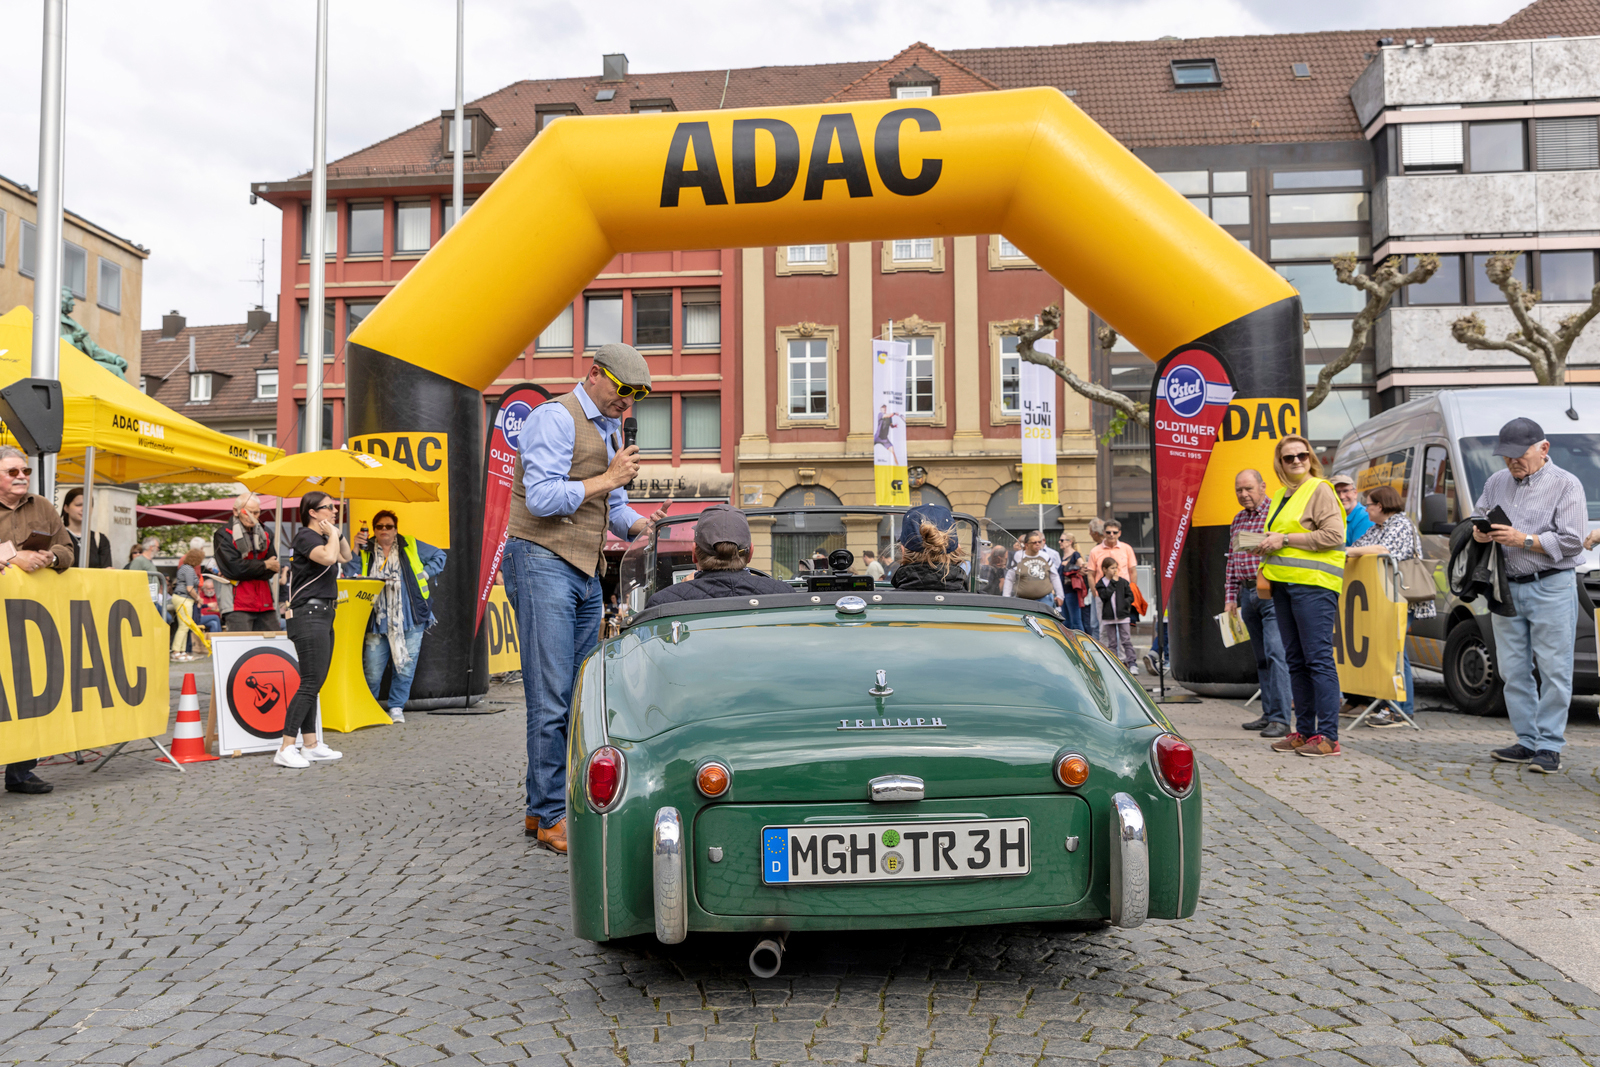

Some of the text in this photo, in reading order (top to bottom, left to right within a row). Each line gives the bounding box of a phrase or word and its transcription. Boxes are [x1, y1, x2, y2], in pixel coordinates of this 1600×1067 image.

[660, 107, 943, 208] ADAC
[1169, 378, 1200, 399] Östol
[1024, 413, 1051, 426] JUNI
[1215, 403, 1297, 442] DAC
[1025, 427, 1052, 440] 2023
[1156, 420, 1215, 436] OLDTIMER
[1172, 433, 1199, 446] OILS
[490, 448, 516, 465] OLDT
[1169, 450, 1202, 460] SINCE 1915
[502, 464, 515, 477] OIL
[1165, 495, 1194, 578] WWW.OESTOL.DE
[840, 717, 943, 728] TRIUMPH
[772, 861, 781, 873] D
[791, 833, 877, 876] MGH
